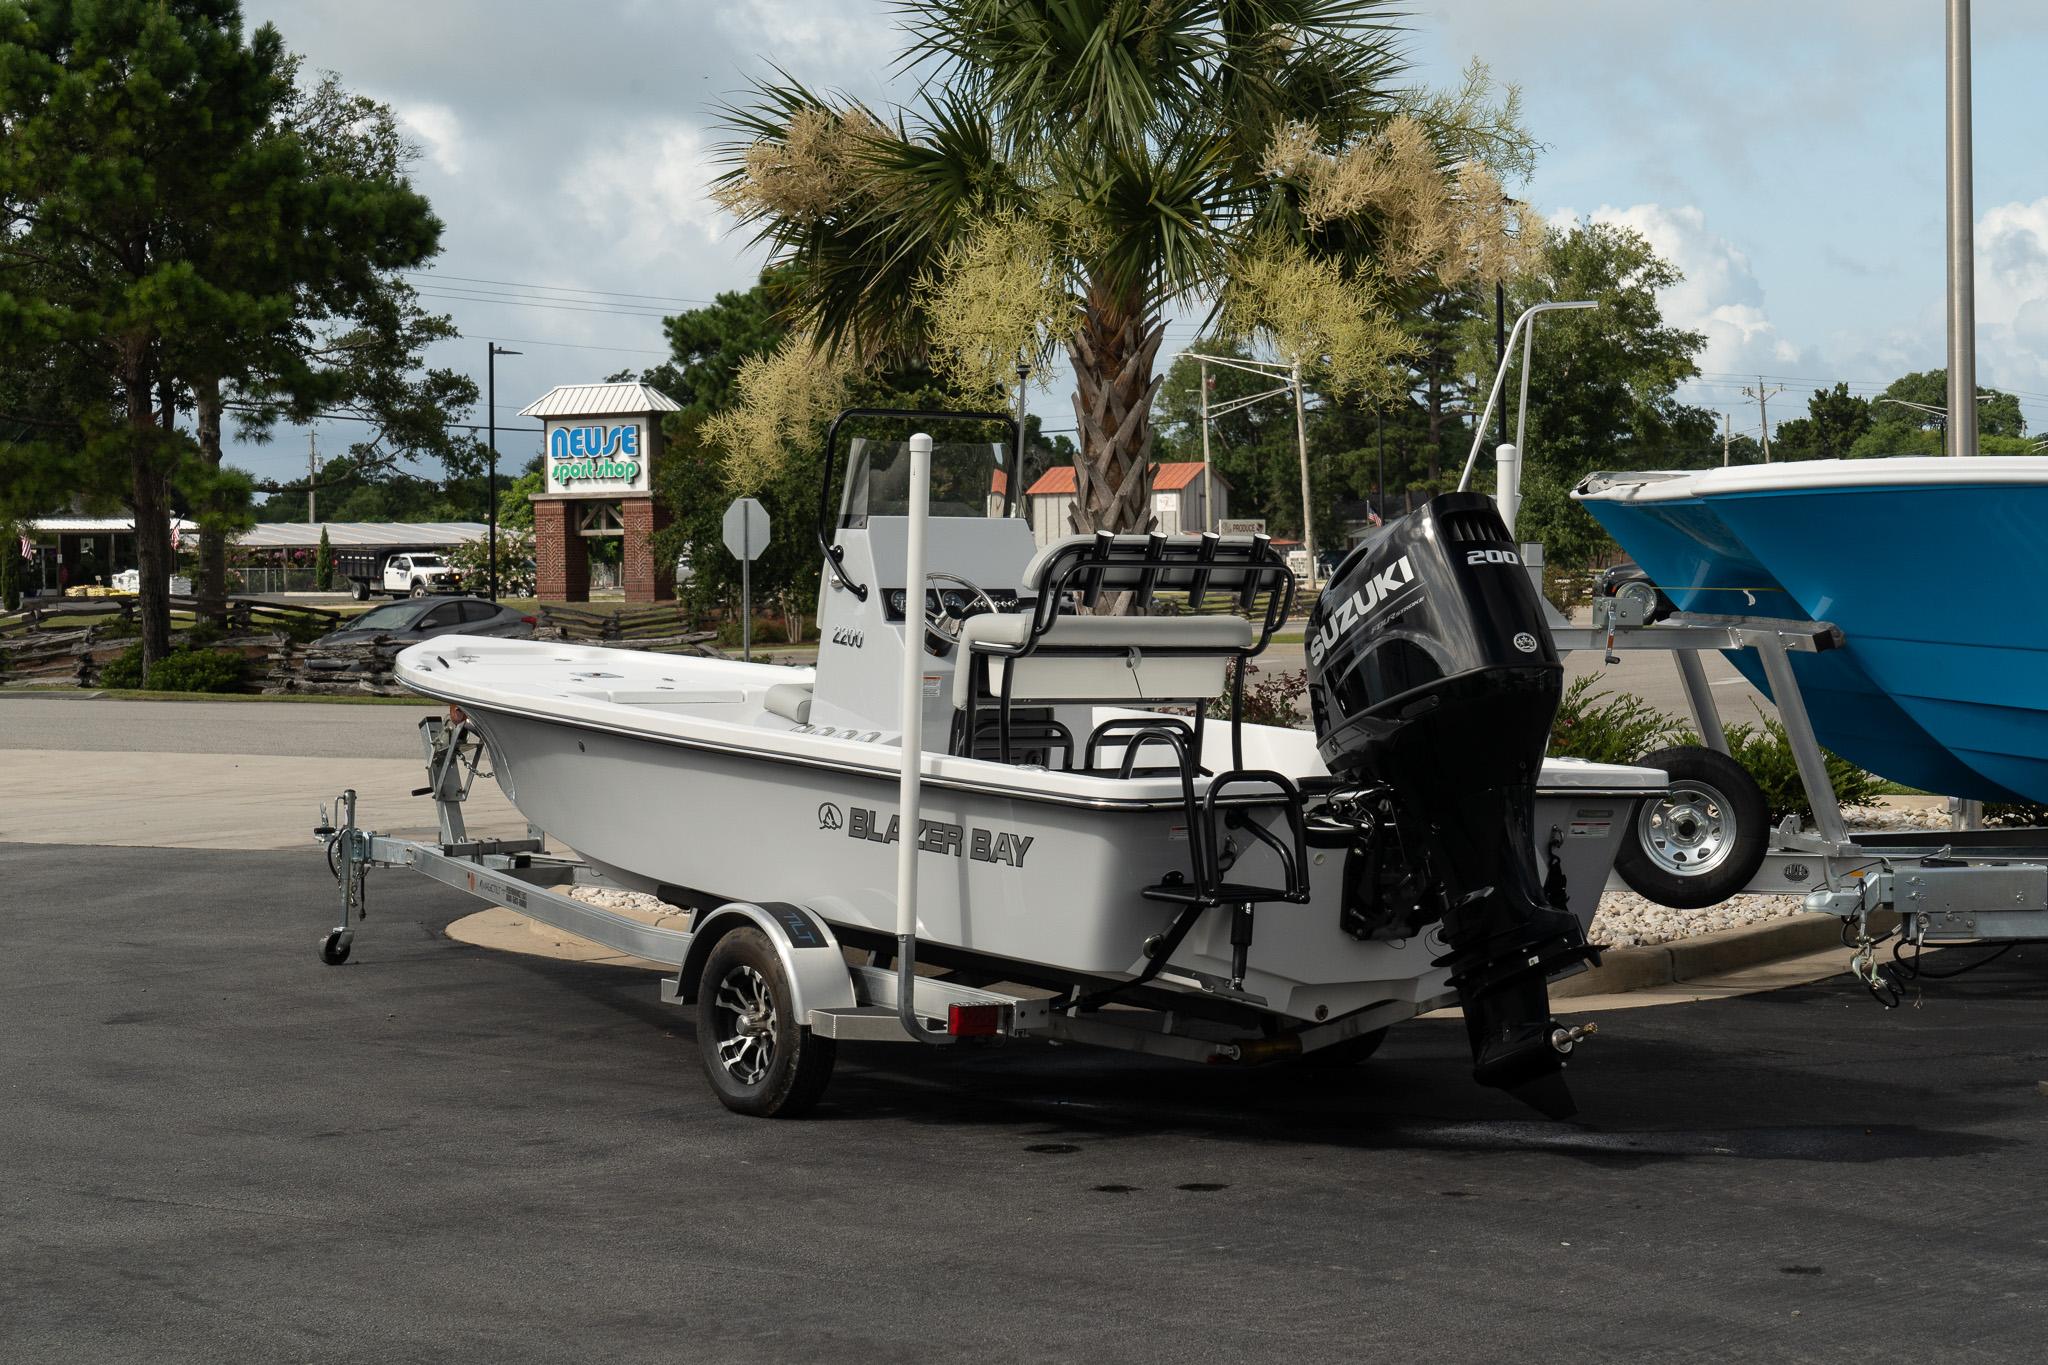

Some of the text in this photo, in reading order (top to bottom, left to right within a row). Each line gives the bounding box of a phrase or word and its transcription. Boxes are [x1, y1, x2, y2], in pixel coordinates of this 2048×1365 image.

[552, 459, 638, 485] sport shop
[1232, 524, 1256, 533] PRODUCE
[1466, 549, 1519, 565] 200
[1310, 555, 1415, 667] SUZUKI
[832, 625, 864, 649] 2200
[969, 827, 1034, 868] BAY
